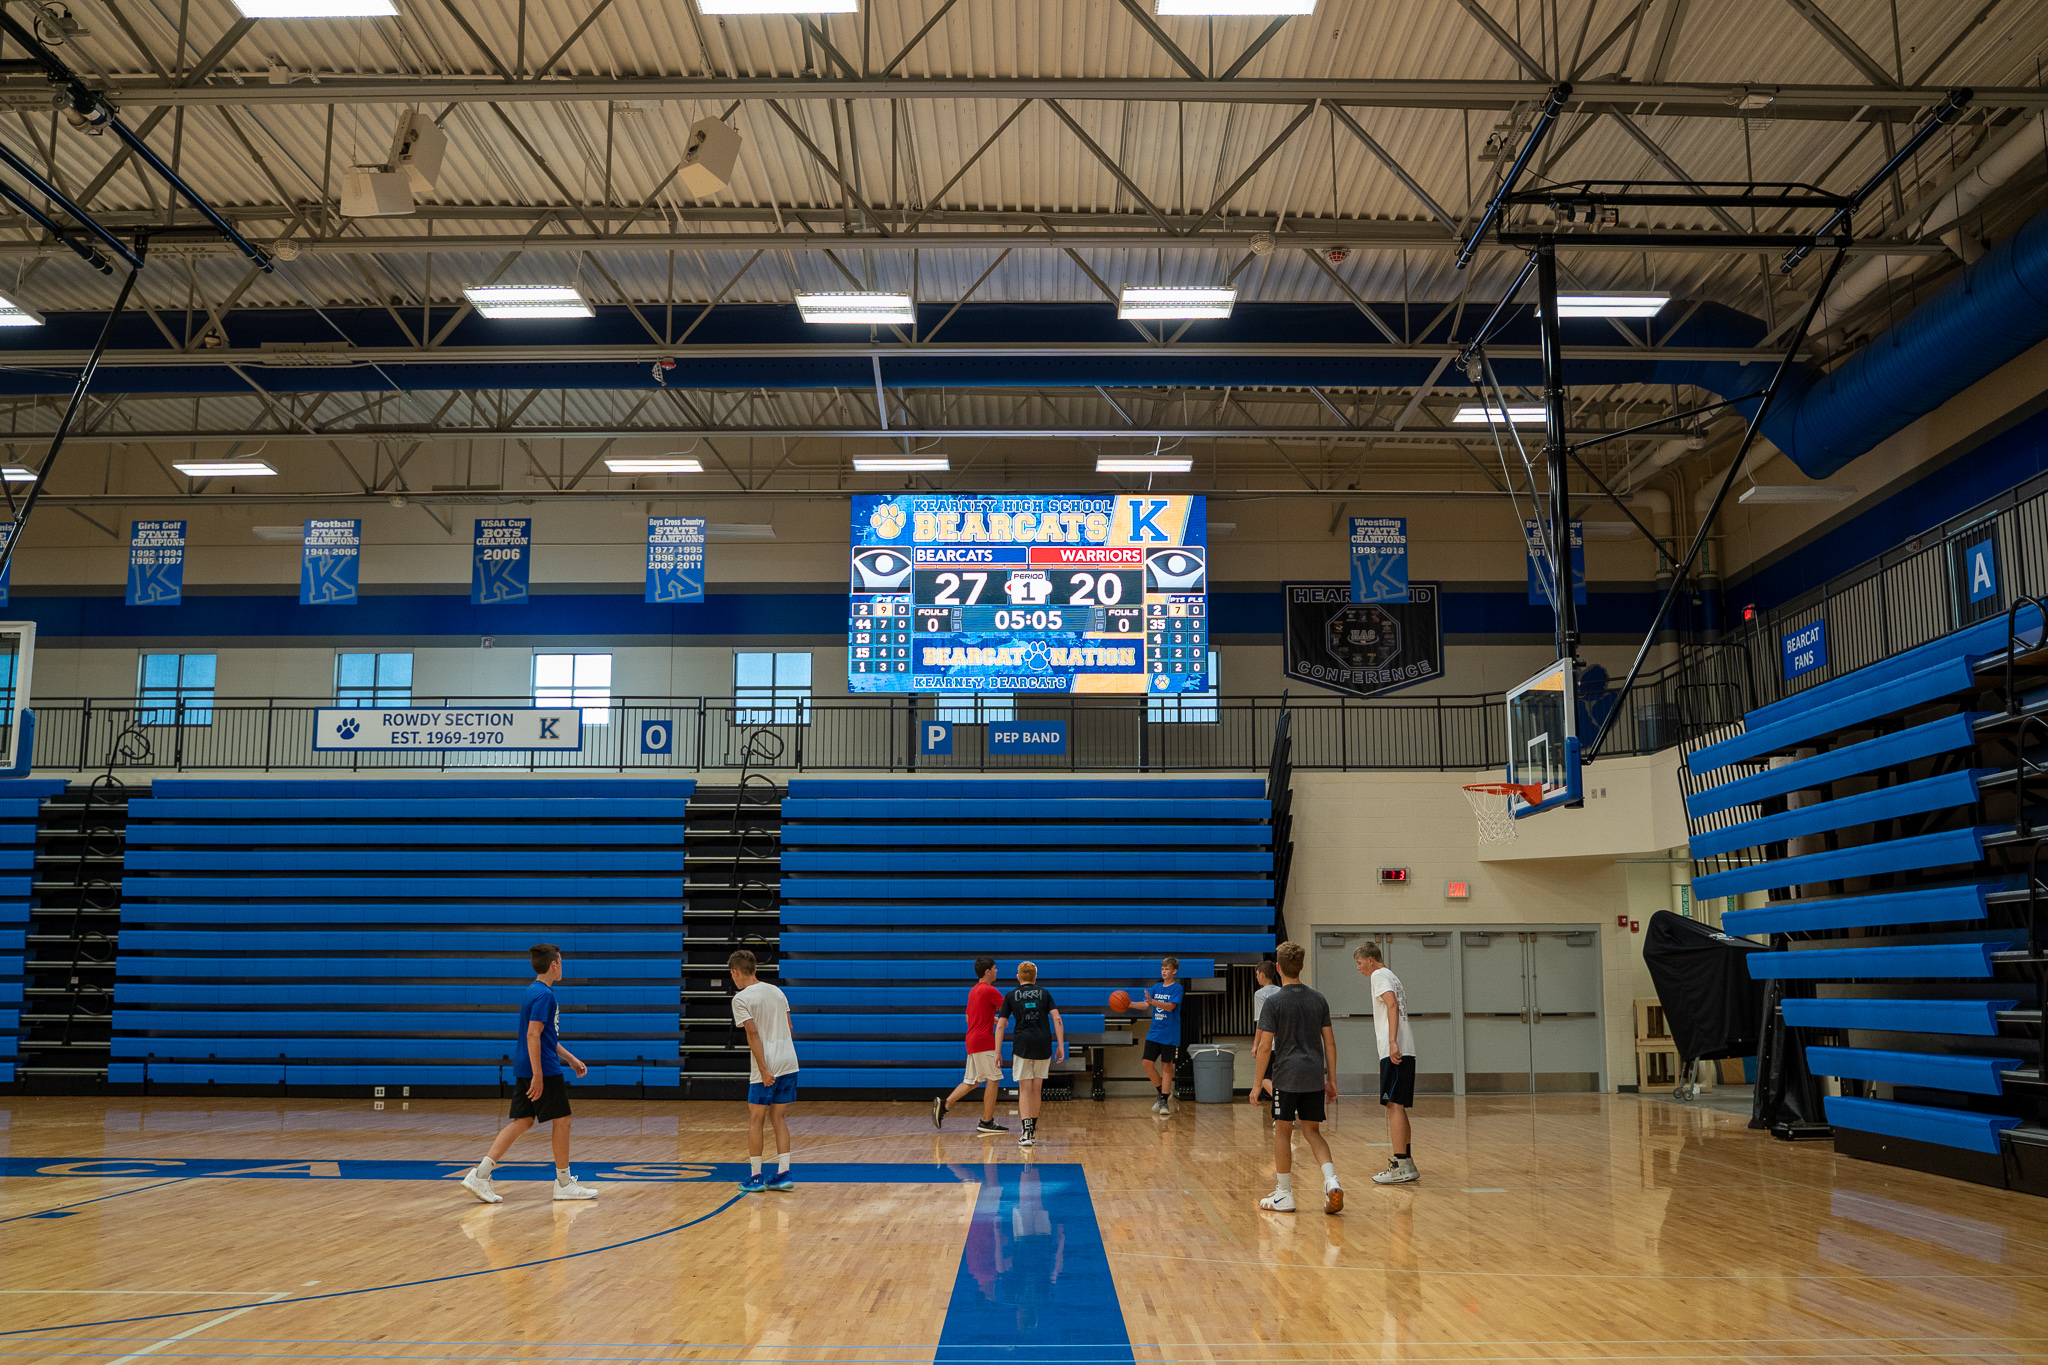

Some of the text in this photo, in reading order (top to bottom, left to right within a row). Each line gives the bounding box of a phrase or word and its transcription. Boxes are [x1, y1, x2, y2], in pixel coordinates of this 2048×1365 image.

[913, 500, 1113, 513] KEARNEY HIGH SCHOOL
[138, 522, 181, 530] Girls Golf
[310, 520, 355, 528] Football
[508, 520, 526, 528] Cup
[664, 518, 681, 526] Cross
[682, 518, 705, 527] Country
[1127, 498, 1171, 544] K
[1354, 519, 1401, 527] Wrestling
[655, 527, 698, 535] STATE
[913, 512, 1109, 542] BEARCATS
[1356, 527, 1399, 535] STATE
[138, 530, 179, 539] STATE
[311, 529, 353, 537] STATE
[482, 528, 522, 538] BOYS
[132, 538, 185, 547] CHAMPIONS
[305, 537, 359, 545] CHAMPIONS
[476, 537, 528, 546] CHAMPION
[649, 535, 705, 543] CHAMPIONS
[1351, 535, 1406, 544] CHAMPIONS
[159, 549, 182, 557] 1994
[483, 548, 521, 561] 2006
[649, 546, 703, 554] 1977 1995
[1352, 546, 1405, 555] 1998 2018
[649, 554, 703, 562] 1996 2000
[916, 549, 993, 562] BEARCATS
[1060, 550, 1141, 562] WARRIORS
[131, 557, 182, 565] 1995 1997
[648, 562, 701, 570] 2003 2011
[1973, 552, 1991, 594] A
[934, 572, 988, 605] 27
[1022, 581, 1036, 601] 1
[1069, 572, 1122, 605] 20
[859, 605, 868, 615] 2
[898, 606, 905, 614] 0
[1153, 605, 1200, 615] 2 7 0
[855, 619, 905, 629] 44 7 0
[927, 618, 938, 632] 0
[994, 610, 1063, 630] 05:05
[1118, 618, 1129, 632] 0
[1150, 619, 1200, 629] 35 6 0
[856, 633, 870, 644] 13
[898, 634, 905, 642] 0
[1153, 634, 1200, 644] 4 3 0
[1350, 629, 1376, 640] HAC
[1786, 626, 1820, 654] BEARCAT
[856, 648, 905, 658] 15 4 0
[922, 646, 1025, 666] BEARCAT
[1050, 647, 1136, 666] NATION
[1154, 648, 1200, 657] 1 2 0
[1794, 650, 1814, 670] FANS
[859, 662, 905, 672] 1 3 0
[1153, 662, 1200, 672] 3 2 0
[1298, 660, 1432, 684] CONFERENCE
[913, 676, 1066, 689] KEARNEY BEARCATS
[382, 713, 514, 727] ROWDY SECTION
[539, 717, 560, 740] K
[391, 731, 504, 745] EST. 1969-1970
[645, 725, 667, 750] O
[928, 725, 946, 749] P
[994, 732, 1060, 743] PEP BAND
[1448, 882, 1466, 897] EXIT
